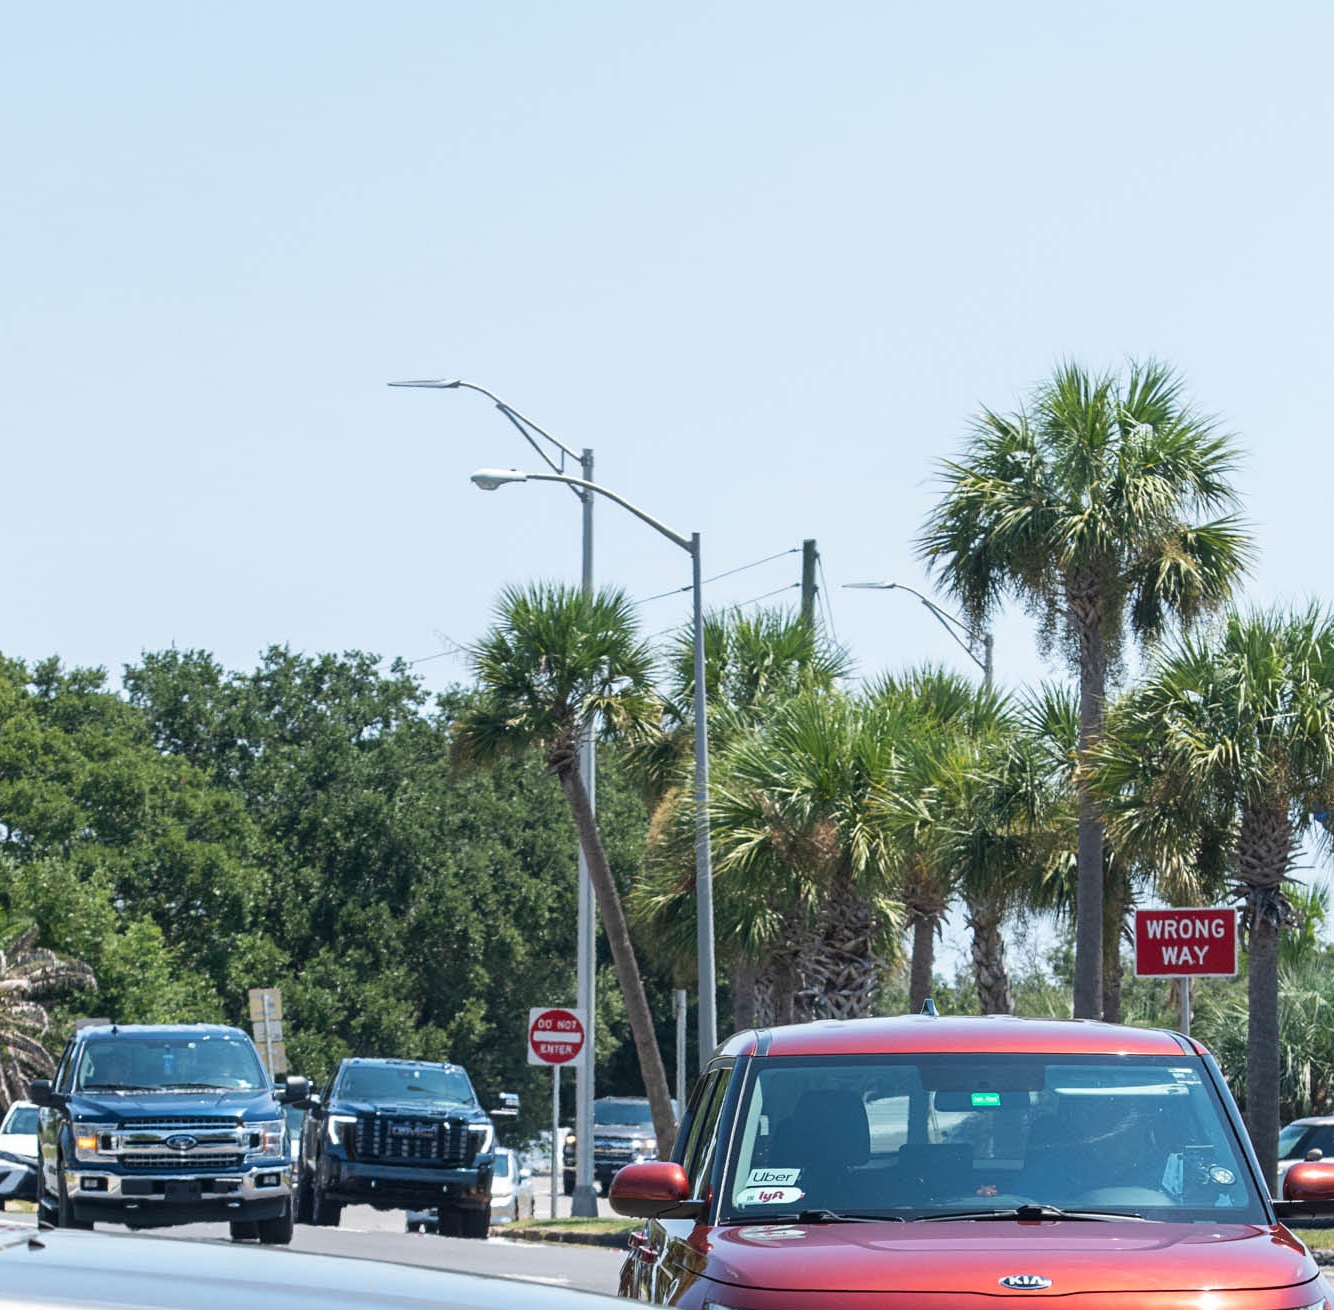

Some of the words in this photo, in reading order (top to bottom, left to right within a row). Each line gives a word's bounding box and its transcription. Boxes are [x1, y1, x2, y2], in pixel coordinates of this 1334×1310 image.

[1147, 919, 1225, 939] WRONG
[1162, 945, 1209, 966] WAY
[538, 1019, 552, 1029] DO
[557, 1020, 577, 1030] NOT
[540, 1044, 572, 1055] ENTER
[753, 1171, 793, 1182] Uber
[759, 1191, 784, 1203] lyft
[1009, 1275, 1044, 1285] KIA
